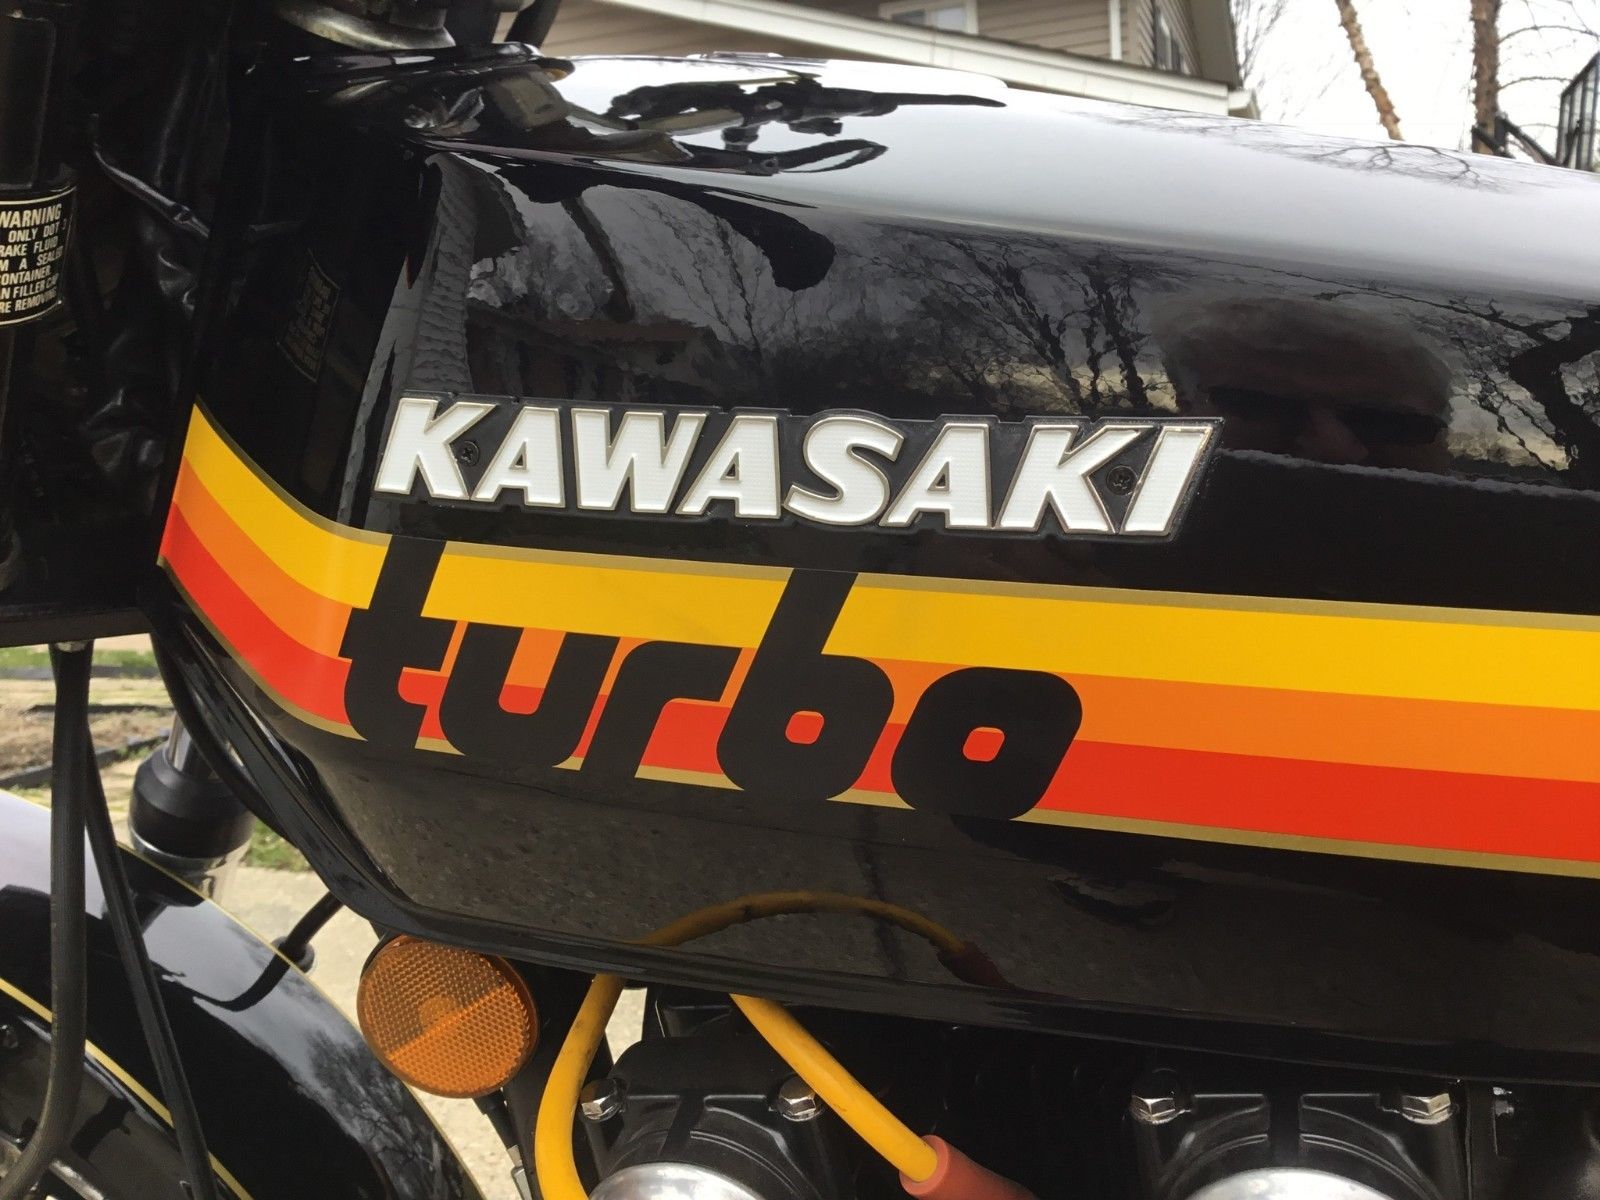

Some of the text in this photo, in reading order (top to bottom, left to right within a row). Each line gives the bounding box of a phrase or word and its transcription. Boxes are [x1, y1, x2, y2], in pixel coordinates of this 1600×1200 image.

[0, 203, 62, 229] WARNING
[8, 227, 39, 243] ONLY
[43, 221, 60, 238] DOT
[18, 257, 28, 271] A
[12, 279, 46, 299] FILLER
[373, 396, 1215, 537] KAWASAKI
[340, 534, 1082, 822] turbo
